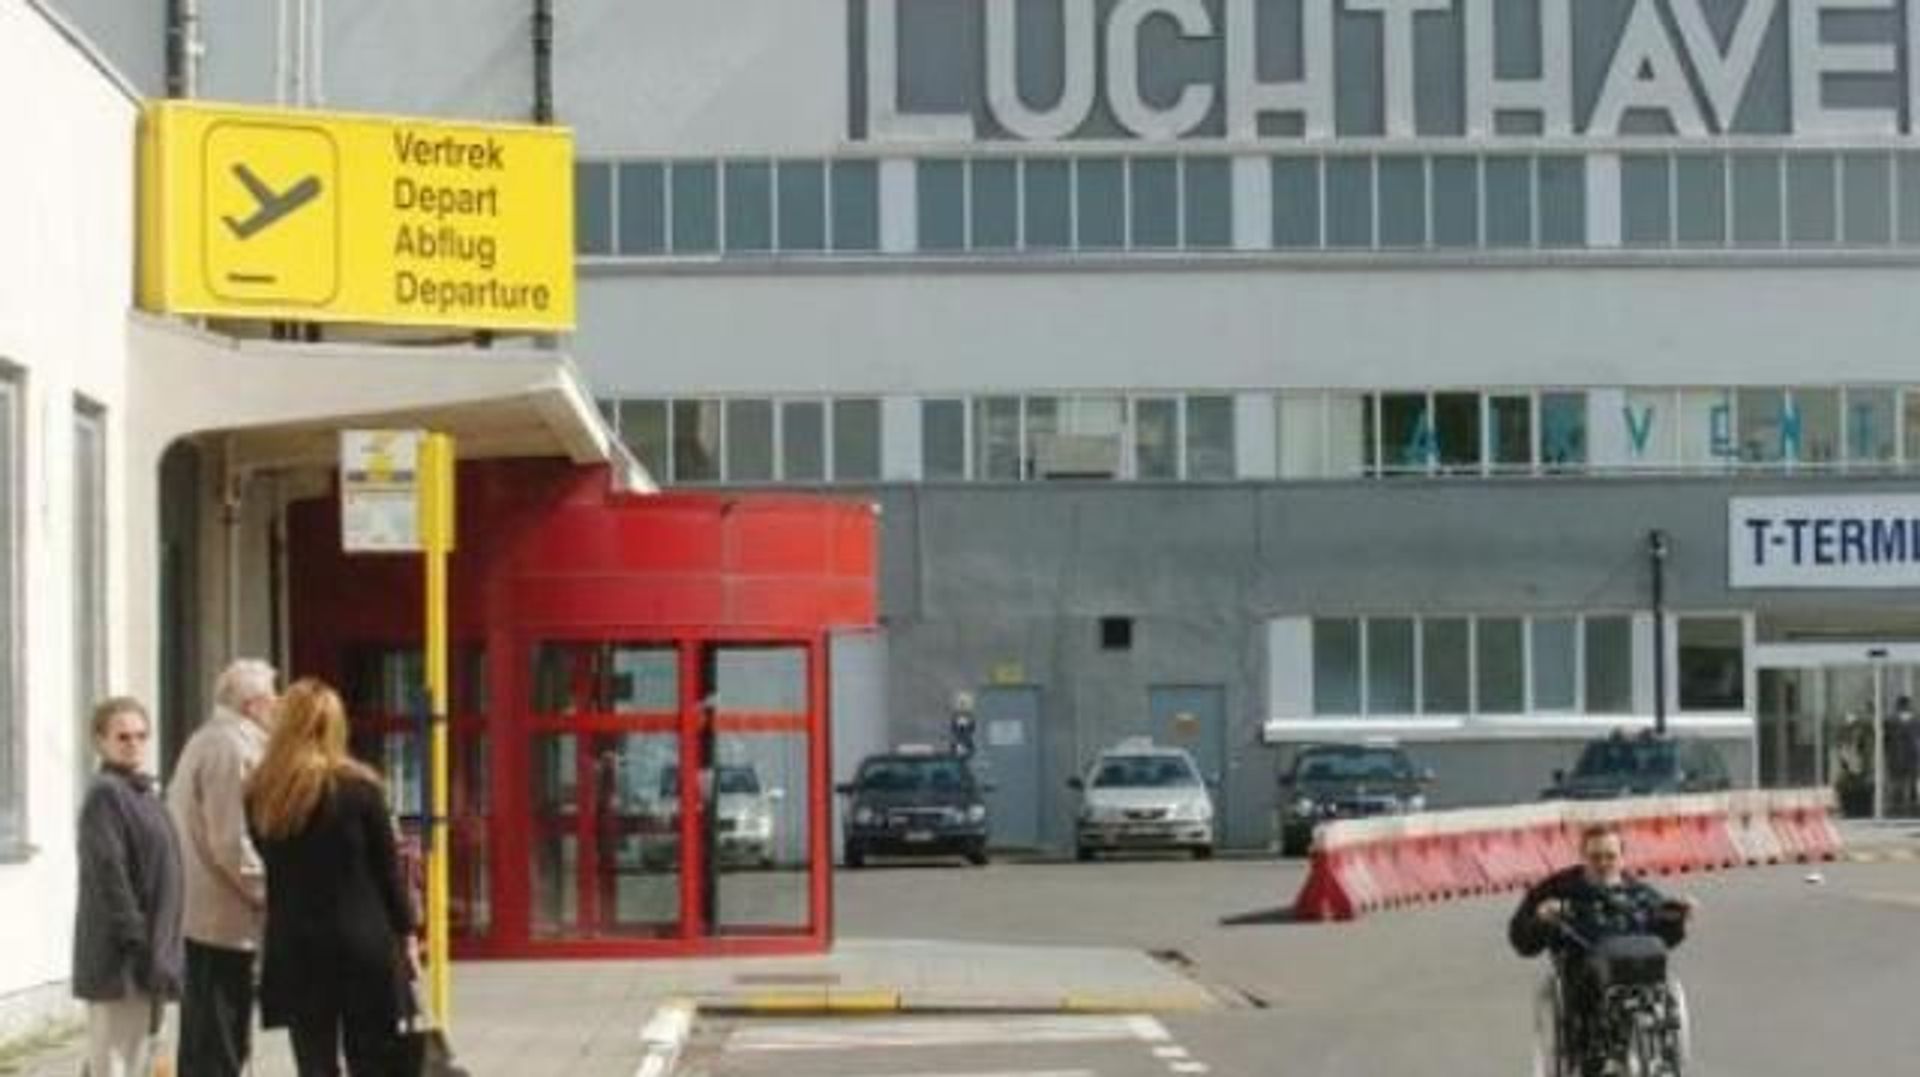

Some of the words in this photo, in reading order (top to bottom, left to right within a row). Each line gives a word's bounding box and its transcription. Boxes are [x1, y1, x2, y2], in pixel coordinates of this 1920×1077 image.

[866, 0, 1920, 139] LUCHTHAVE
[394, 130, 505, 170] Vertrek
[393, 176, 498, 220] Depart
[394, 222, 497, 269] Abflug
[394, 269, 551, 312] Departure
